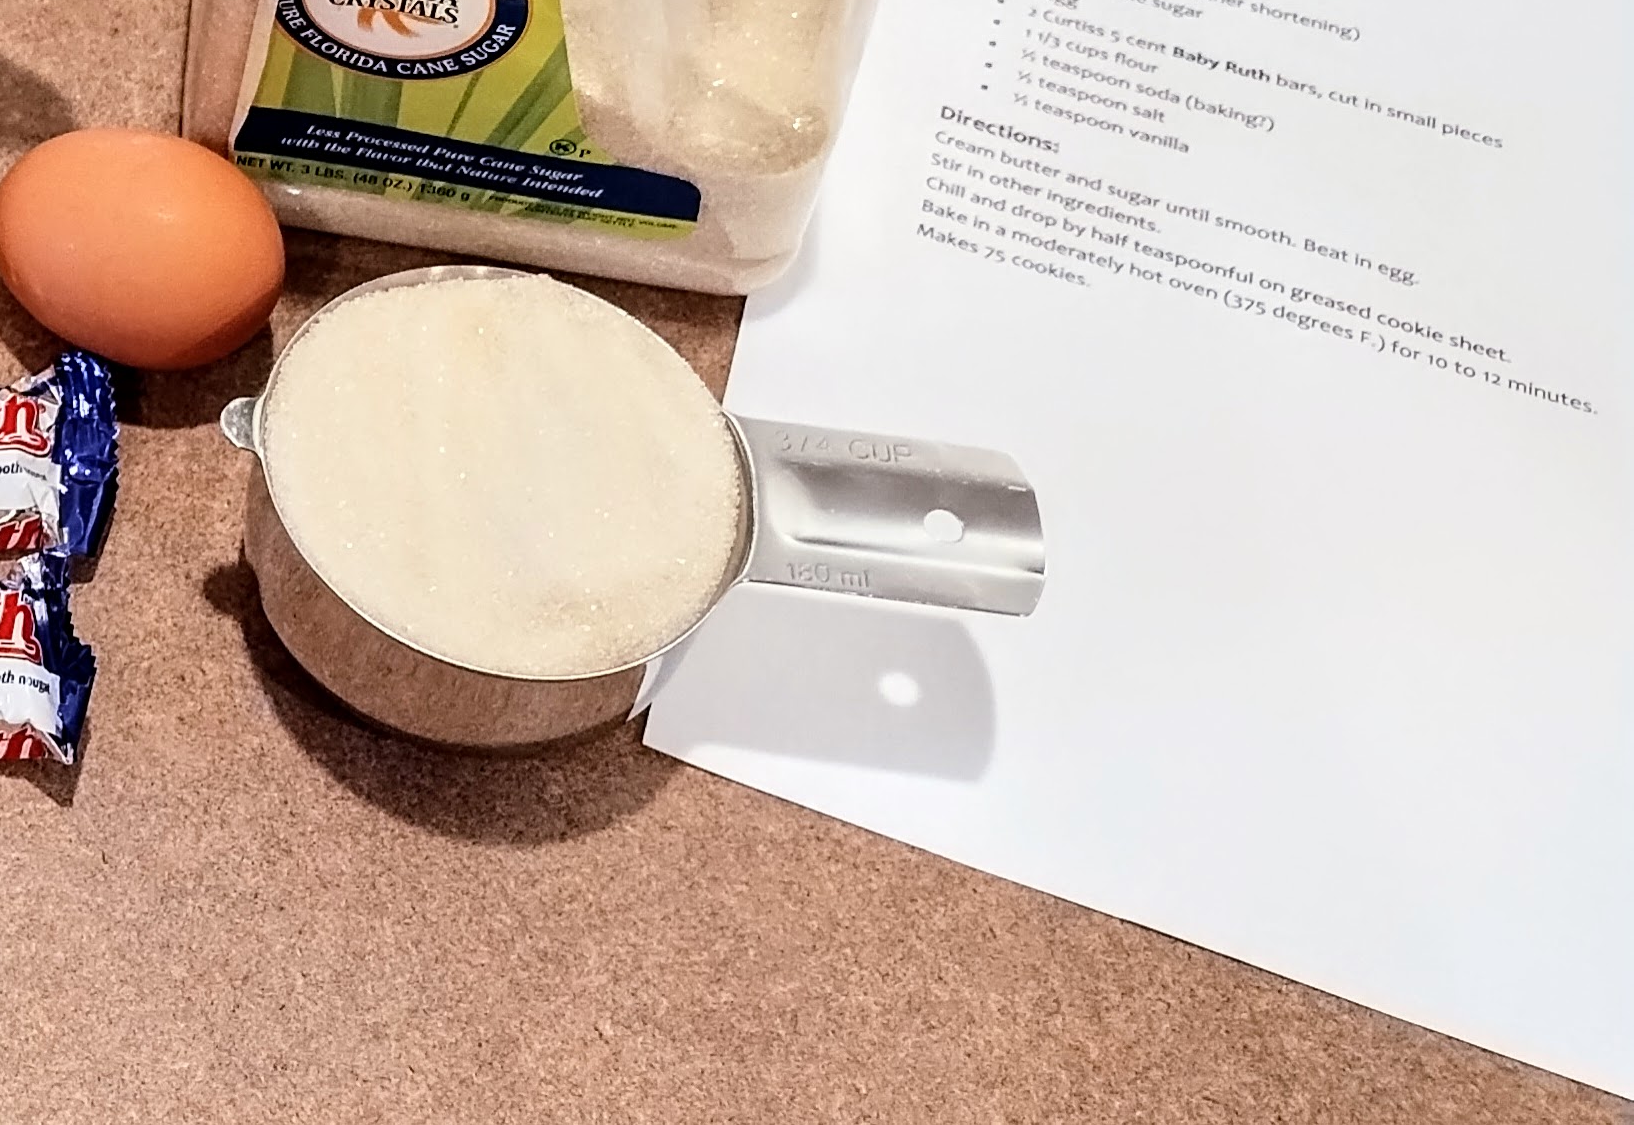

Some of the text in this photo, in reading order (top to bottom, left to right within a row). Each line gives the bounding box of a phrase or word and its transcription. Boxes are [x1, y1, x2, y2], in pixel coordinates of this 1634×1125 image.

[300, 28, 388, 73] FLORIDA
[396, 58, 459, 75] CANE
[460, 23, 516, 67] SUGAR
[1028, 8, 1502, 148] 2 Curtiss 5 cent Baby Ruth bars, cut in small pieces
[940, 105, 1058, 153] Directions:
[934, 130, 1420, 286] Cream butter and sugar until smooth. Beat in egg.
[916, 223, 1089, 285] Makes 75 cookies.
[921, 199, 1598, 413] Bake in a moderately hot oven (375 degrees F.) for 10 to 12 minutes.
[848, 439, 912, 464] CUP
